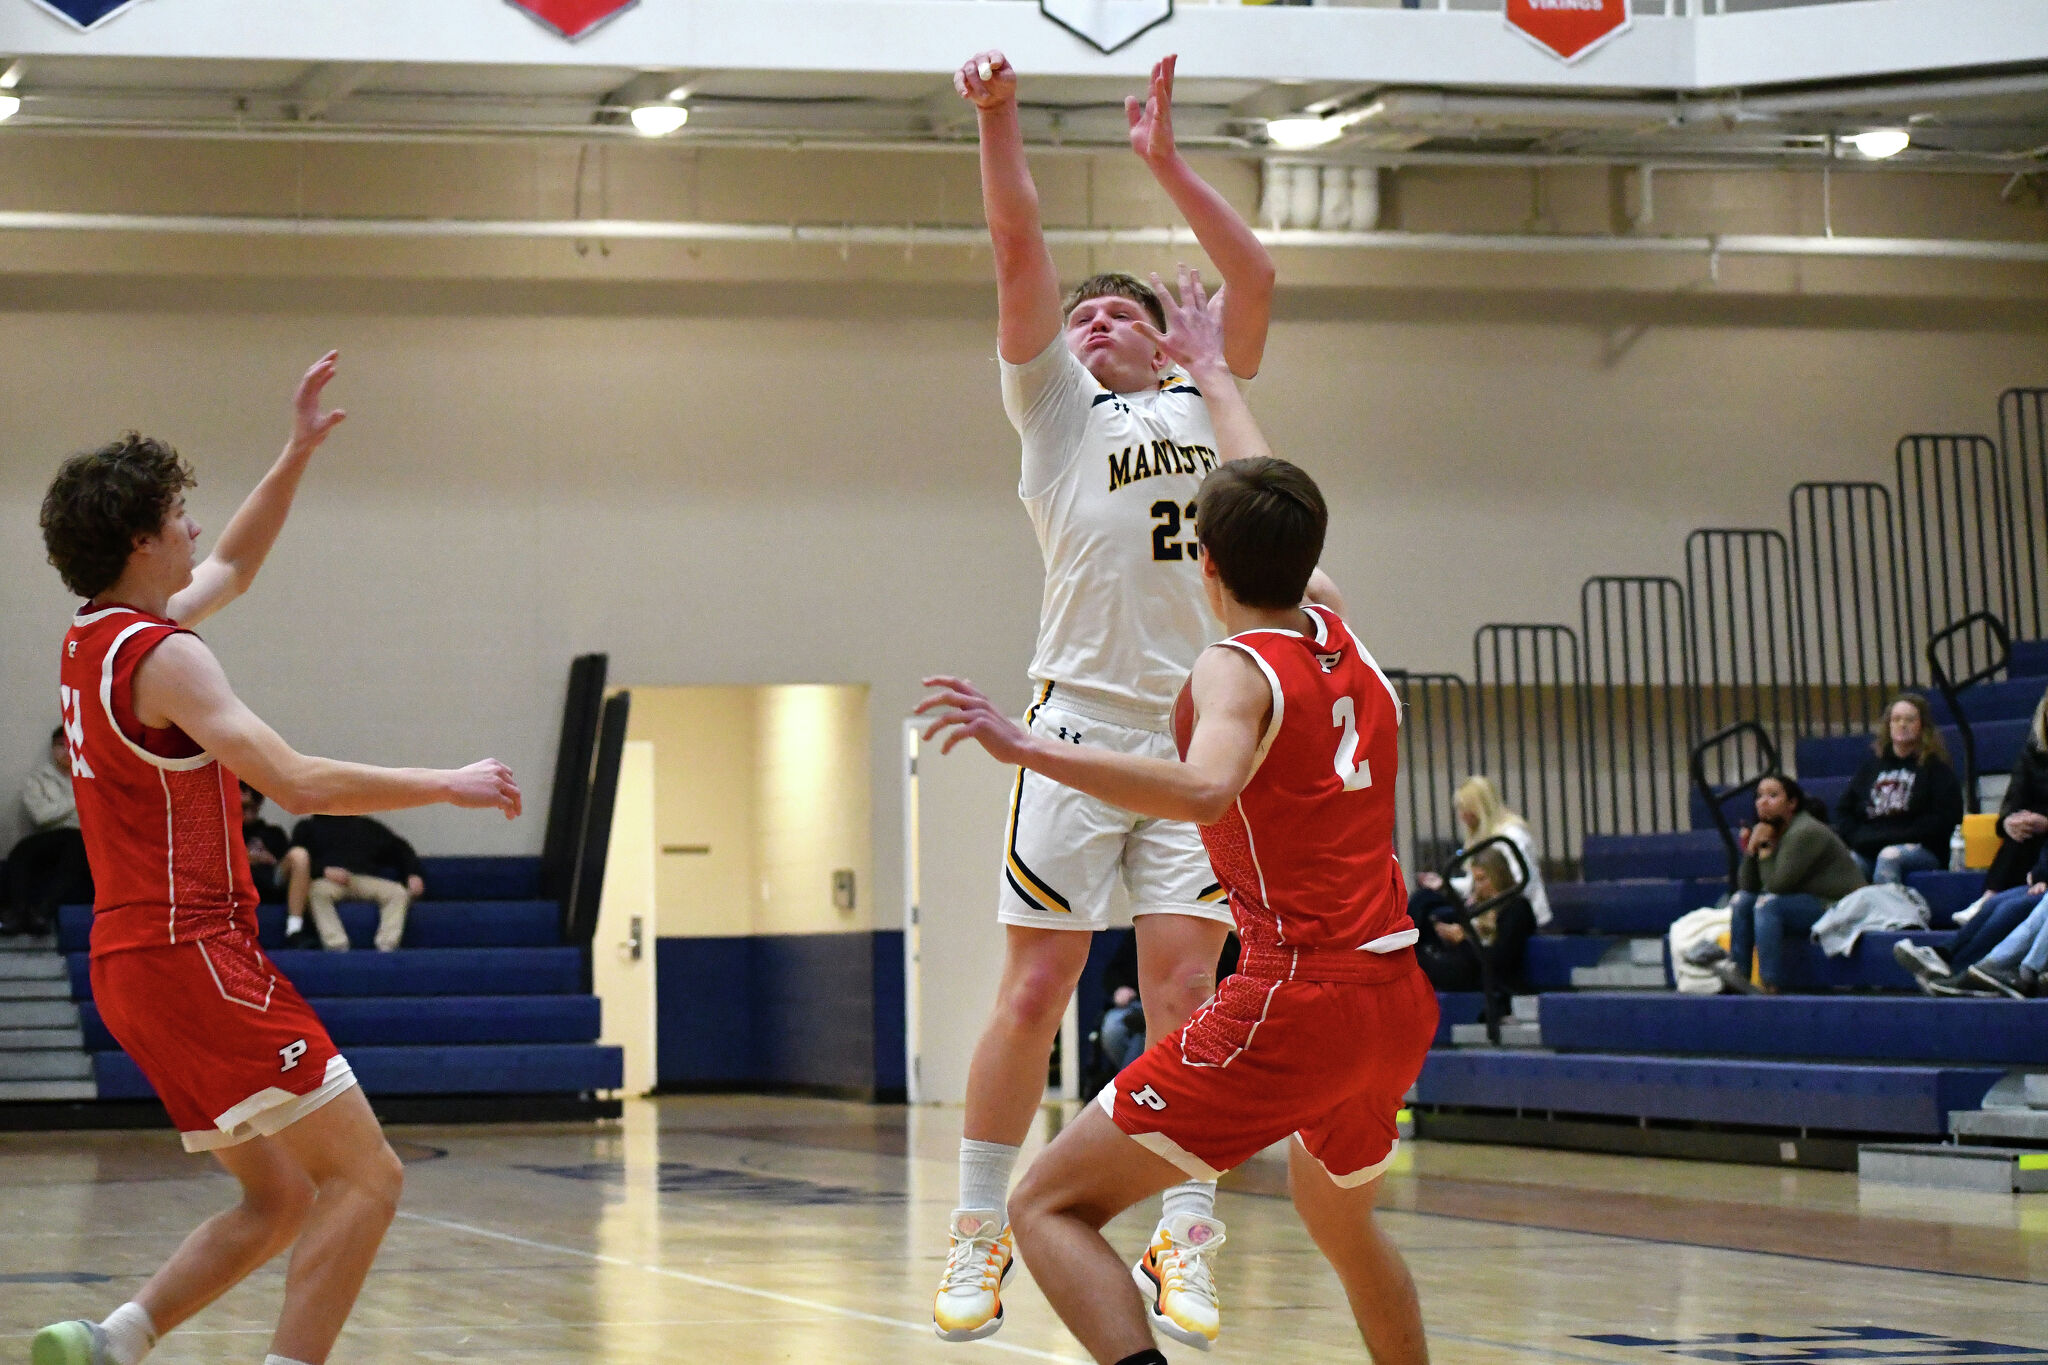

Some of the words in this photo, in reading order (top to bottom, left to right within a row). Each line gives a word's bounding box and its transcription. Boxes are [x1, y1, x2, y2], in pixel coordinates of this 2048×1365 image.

[1315, 650, 1342, 674] P
[1332, 695, 1373, 792] 2
[279, 1038, 308, 1073] P
[1130, 1083, 1167, 1111] P
